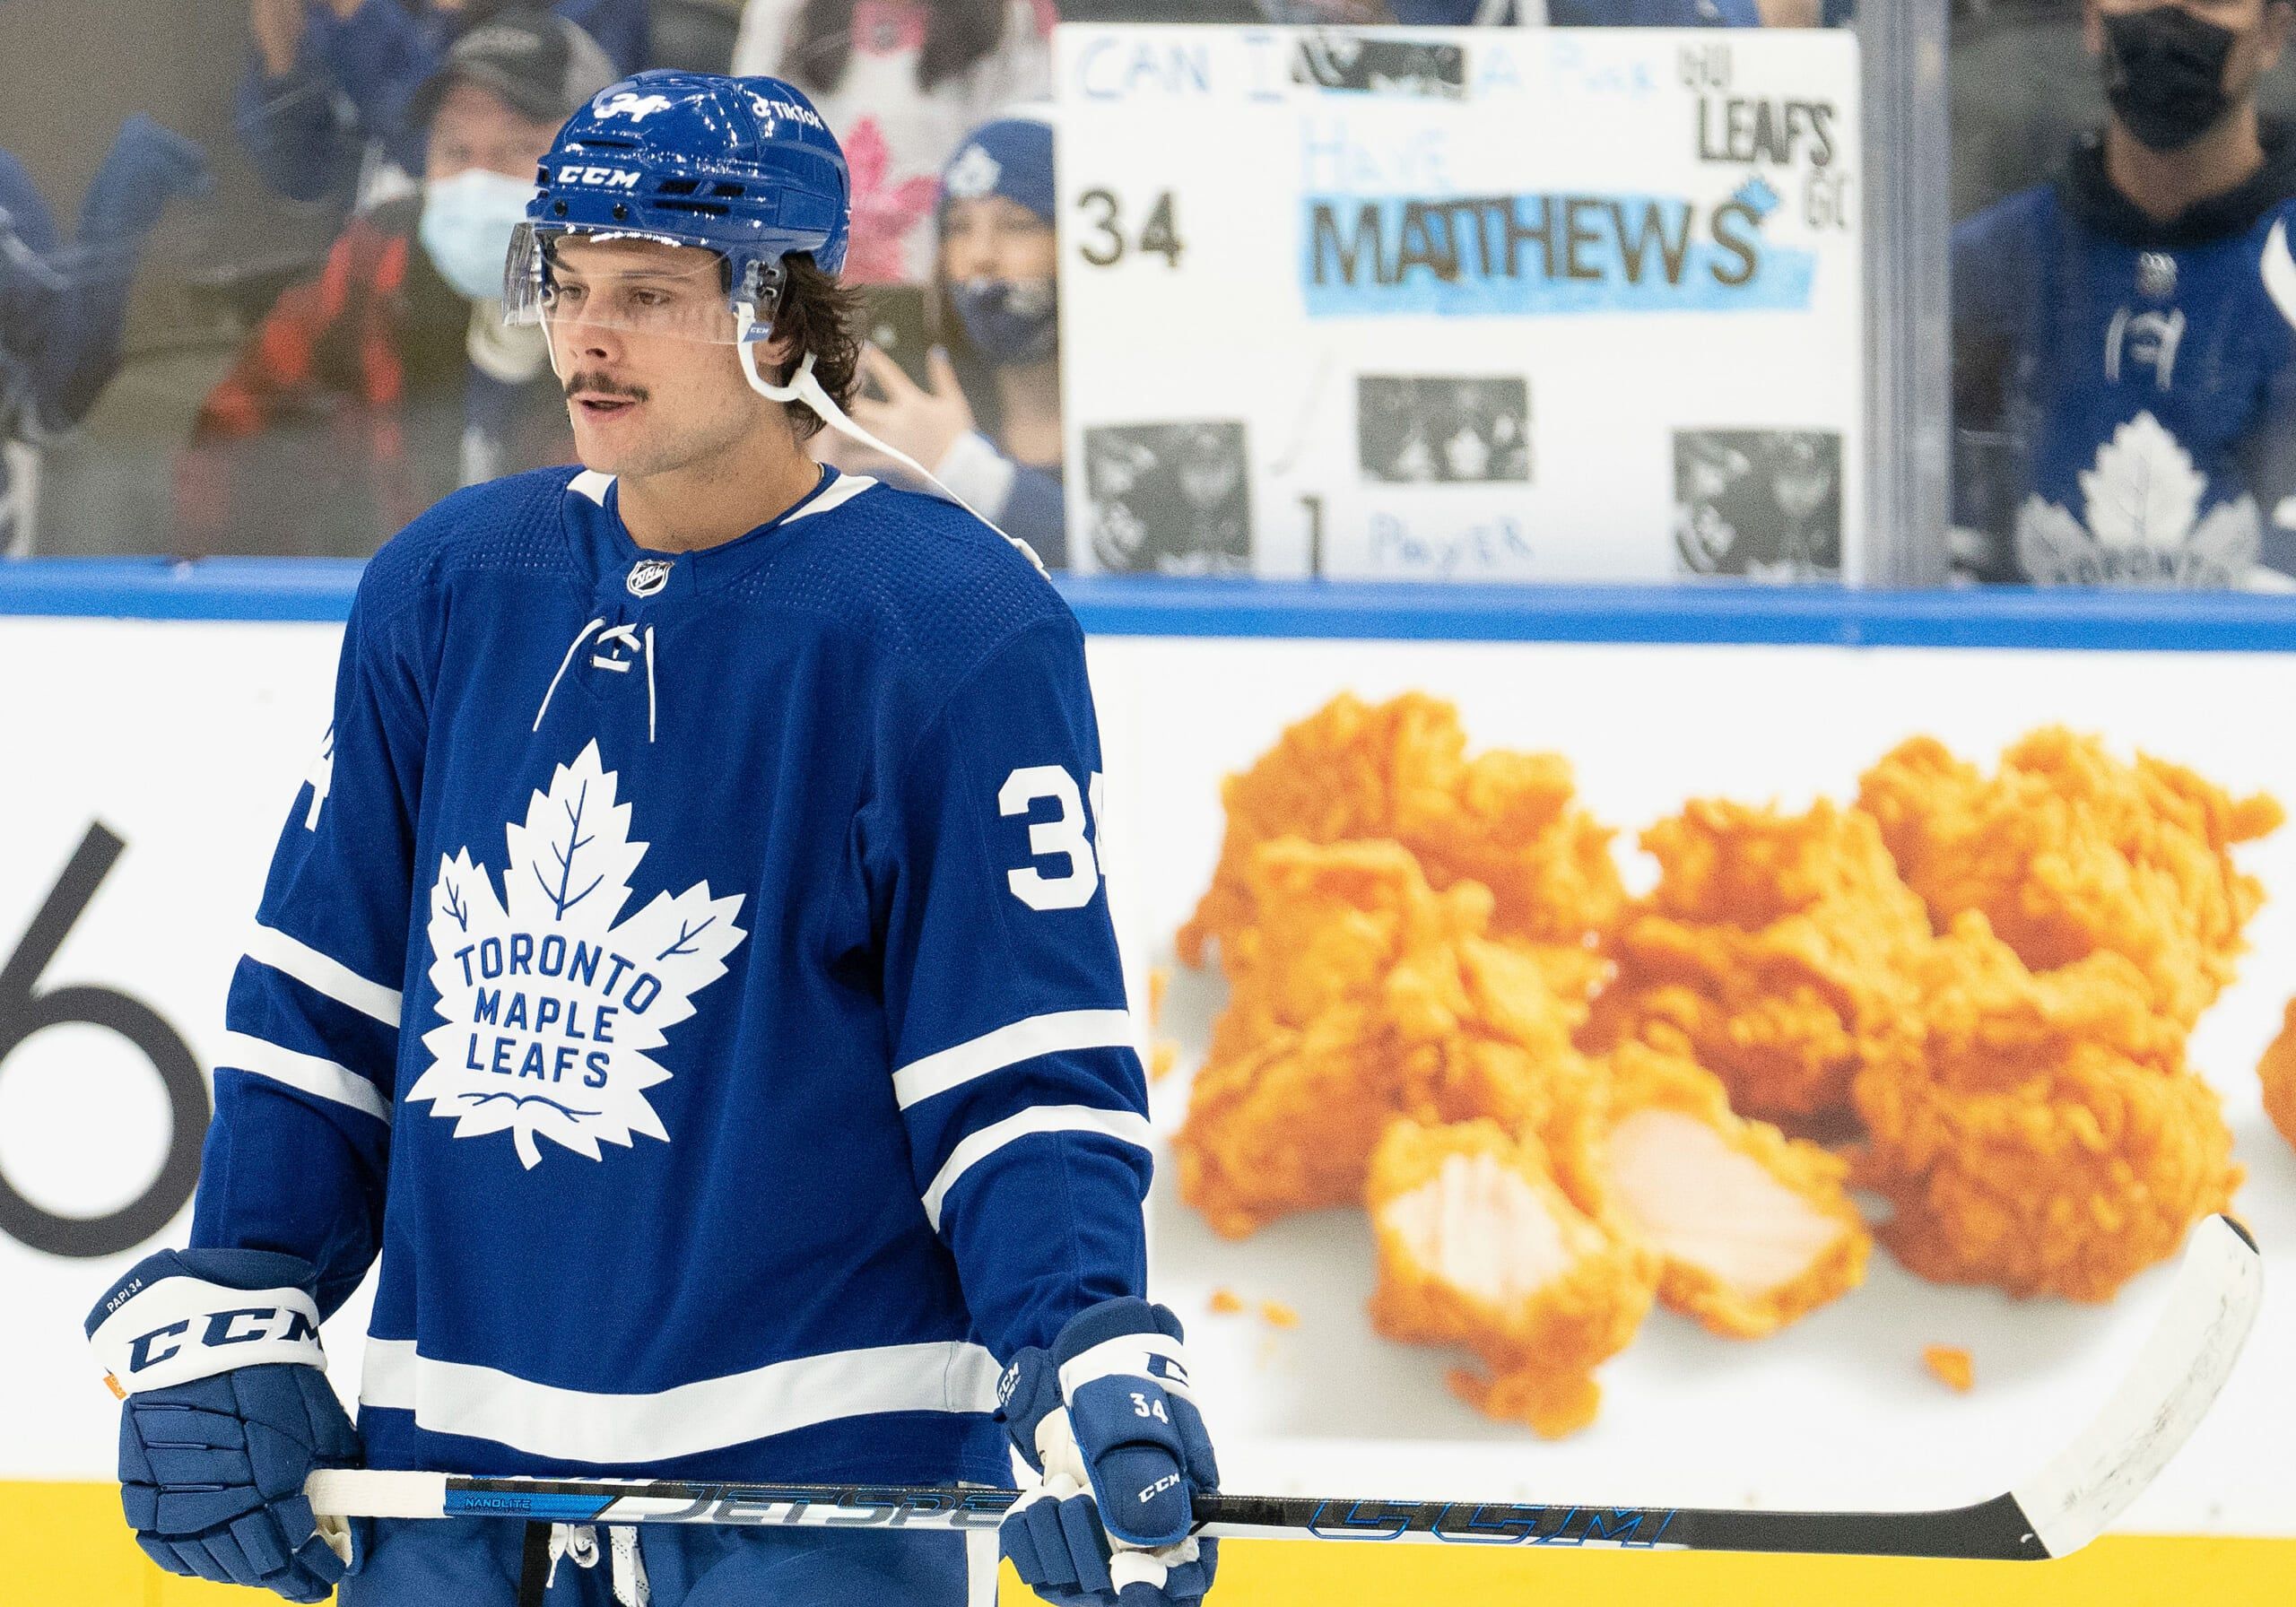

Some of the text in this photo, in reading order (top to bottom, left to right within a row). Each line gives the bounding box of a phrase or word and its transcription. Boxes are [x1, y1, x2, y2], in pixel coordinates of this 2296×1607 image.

[1080, 37, 1211, 101] CAN
[1242, 31, 1286, 103] I
[1476, 44, 1522, 95] A
[594, 92, 671, 123] 34
[771, 100, 824, 130] TikTok
[1697, 95, 1838, 168] LEAFS
[558, 165, 642, 189] CCM
[1077, 188, 1186, 269] 34
[1311, 197, 1761, 287] MATTHEWS
[750, 326, 770, 334] CCM
[635, 564, 665, 587] NHL
[454, 933, 662, 1015] TORONTO
[474, 988, 619, 1044] MAPLE
[0, 820, 212, 1259] 6
[465, 1032, 610, 1089] LEAFS
[107, 1278, 143, 1313] PAPI 34
[127, 1307, 325, 1374] CCM
[998, 1362, 1020, 1404] CCM
[1130, 1393, 1169, 1425] 34
[465, 1498, 532, 1509] NANOLITE
[1137, 1472, 1180, 1503] CCM
[1307, 1498, 1677, 1549] CCM
